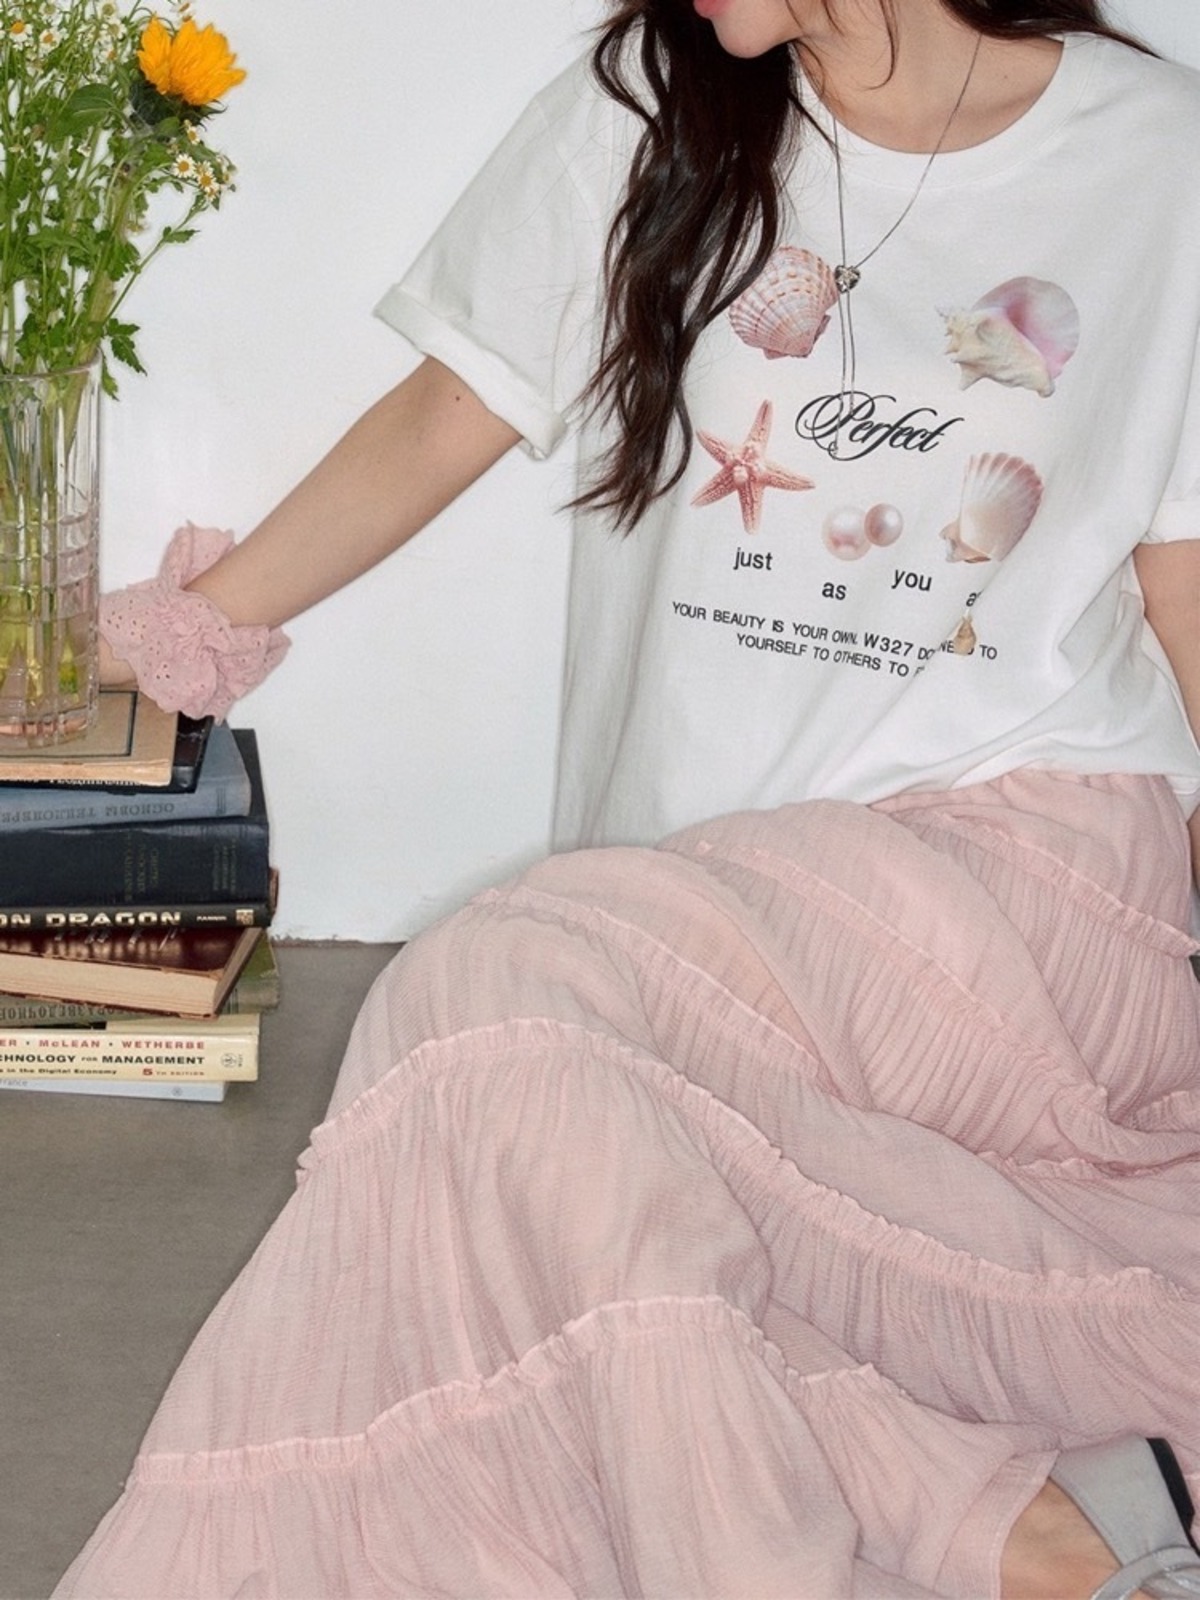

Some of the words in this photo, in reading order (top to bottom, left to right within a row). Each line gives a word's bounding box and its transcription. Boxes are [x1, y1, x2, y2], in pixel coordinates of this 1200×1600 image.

[794, 390, 965, 462] Perfect
[733, 547, 773, 571] just
[821, 581, 847, 601] as
[891, 569, 933, 592] you
[672, 602, 707, 620] YOUR
[713, 610, 765, 630] BEAUTY
[772, 619, 785, 632] IS
[792, 621, 828, 641] YOUR
[864, 633, 914, 658] W327
[980, 644, 998, 660] TO
[736, 633, 807, 657] YOURSELF
[813, 647, 830, 661] TO
[833, 649, 881, 671] OTHERS
[888, 661, 909, 677] TO
[105, 803, 175, 816] ОСНОВЫ
[46, 911, 182, 927] DRAGON
[39, 1039, 101, 1048] McLEAN
[122, 1041, 205, 1050] WETHERBE
[0, 1054, 76, 1063] HNOLOGY
[102, 1056, 205, 1065] MANAGEMENT
